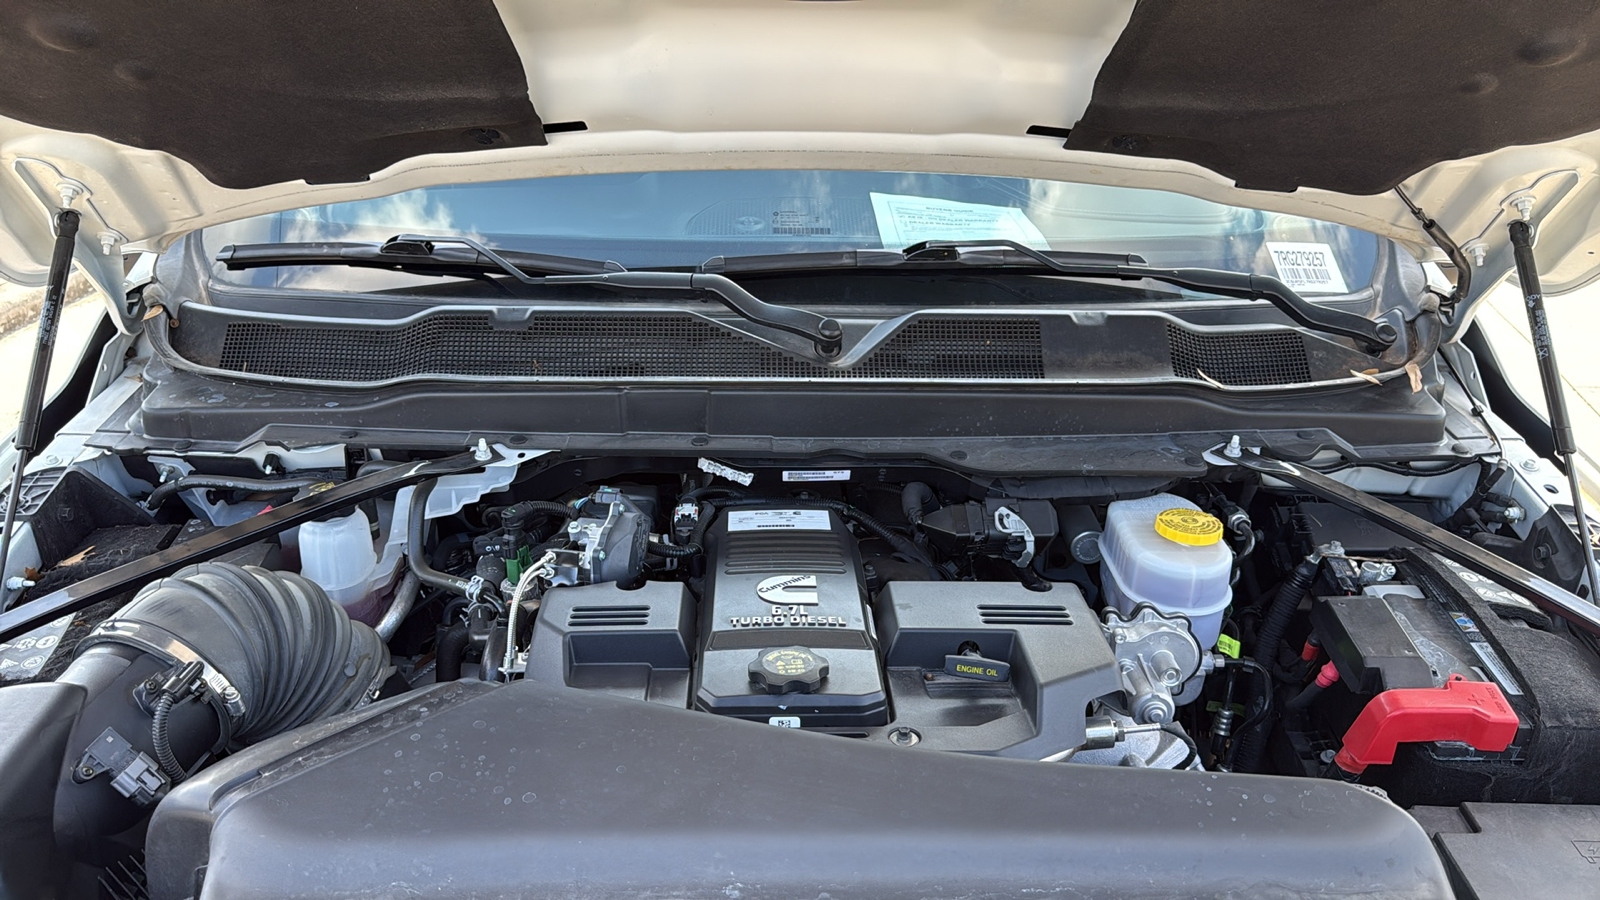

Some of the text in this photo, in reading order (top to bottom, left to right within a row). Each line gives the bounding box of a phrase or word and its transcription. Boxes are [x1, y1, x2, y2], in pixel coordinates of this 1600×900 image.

[1273, 250, 1327, 267] 7RG279257
[758, 575, 812, 593] Cummins
[771, 605, 808, 616] 6.7L
[731, 615, 847, 627] TURBO DIESEL
[956, 664, 998, 677] ENGINE OIL
